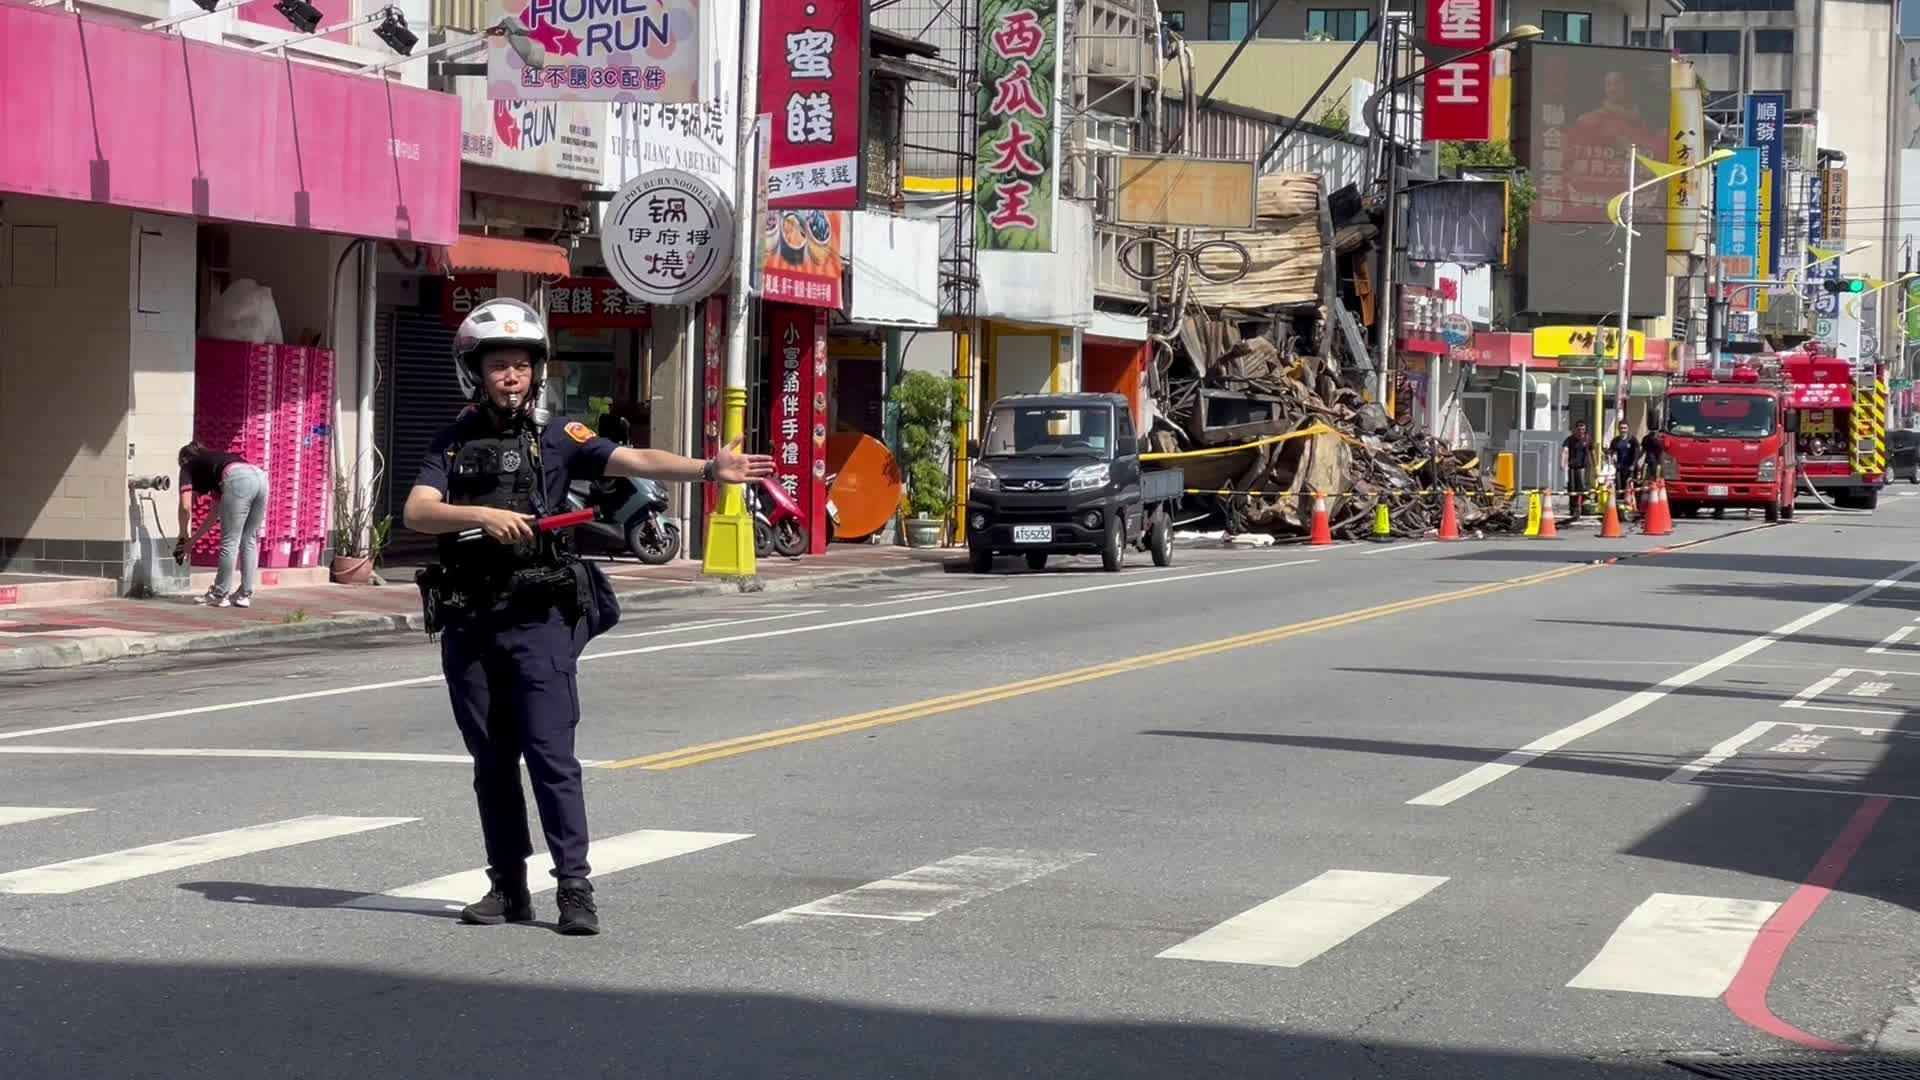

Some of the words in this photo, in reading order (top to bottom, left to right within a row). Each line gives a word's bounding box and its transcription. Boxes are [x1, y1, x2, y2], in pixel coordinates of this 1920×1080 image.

[586, 12, 670, 57] RUN
[521, 65, 666, 90] 紅不讓3C配件
[521, 103, 558, 151] RUN
[990, 8, 1046, 229] 西瓜大王
[1756, 102, 1777, 141] 順發
[767, 164, 853, 194] 台灣嚴選
[781, 321, 801, 466] 小富翁伴手禮
